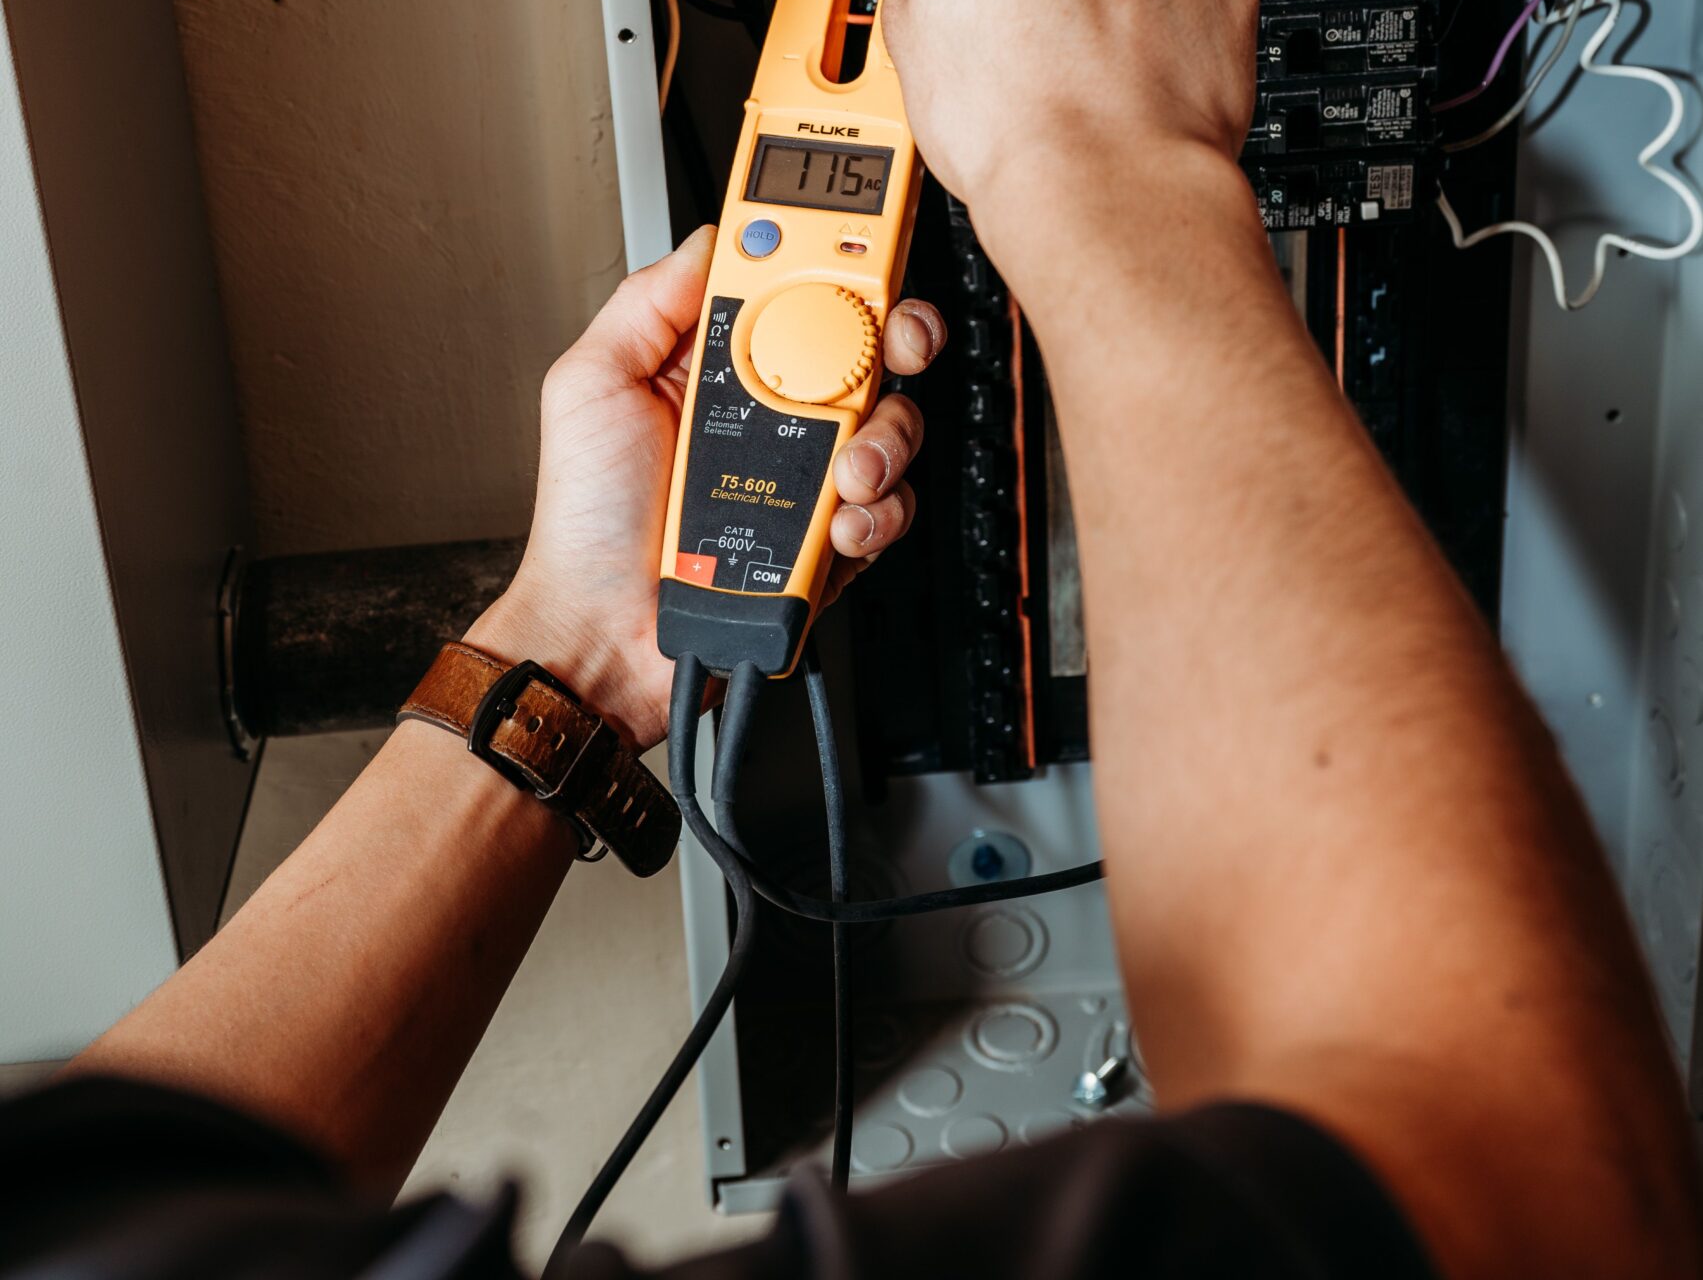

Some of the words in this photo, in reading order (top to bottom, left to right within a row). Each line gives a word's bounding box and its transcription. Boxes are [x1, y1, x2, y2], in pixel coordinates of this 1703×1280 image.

[1270, 47, 1281, 62] 15
[798, 122, 860, 138] FLUKE
[1270, 123, 1281, 139] 15
[798, 151, 863, 196] 115
[864, 178, 882, 191] AC
[1370, 167, 1381, 197] TEST
[1271, 189, 1282, 204] 20
[746, 230, 774, 241] HOLD
[714, 370, 725, 384] A
[709, 410, 738, 420] AC/DC
[740, 407, 751, 420] V
[704, 426, 742, 437] Selection
[705, 420, 744, 430] Automatic
[778, 424, 806, 439] OFF
[720, 474, 777, 494] T5-600
[710, 488, 760, 504] Electrical
[763, 495, 796, 510] Tester
[724, 526, 744, 536] CAT
[718, 536, 756, 552] 600V
[752, 570, 782, 584] COM
